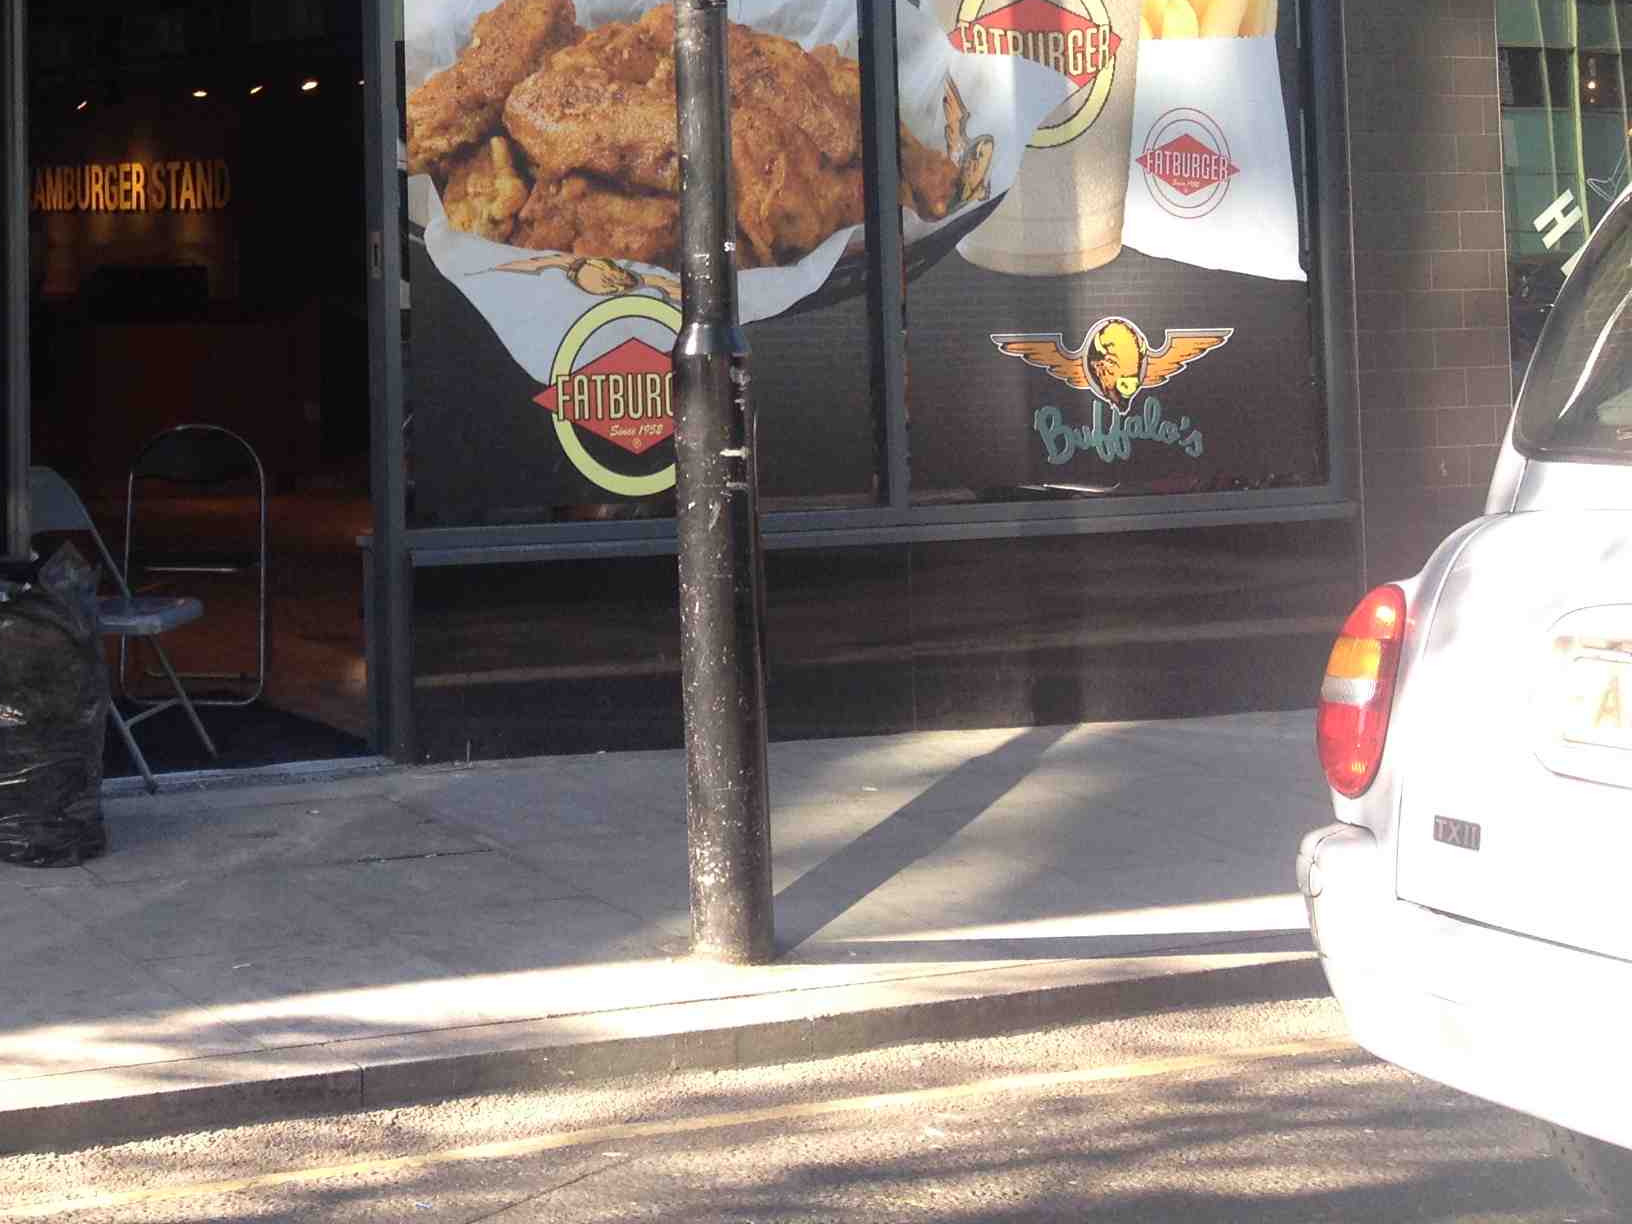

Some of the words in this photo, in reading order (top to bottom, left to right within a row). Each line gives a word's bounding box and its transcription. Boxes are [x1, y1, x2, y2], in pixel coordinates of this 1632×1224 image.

[32, 162, 146, 211] AMBURGER
[149, 159, 231, 210] STAND
[1145, 149, 1229, 184] FATBURGER
[557, 372, 673, 422] FATBUR
[1032, 396, 1204, 465] Buffalo's
